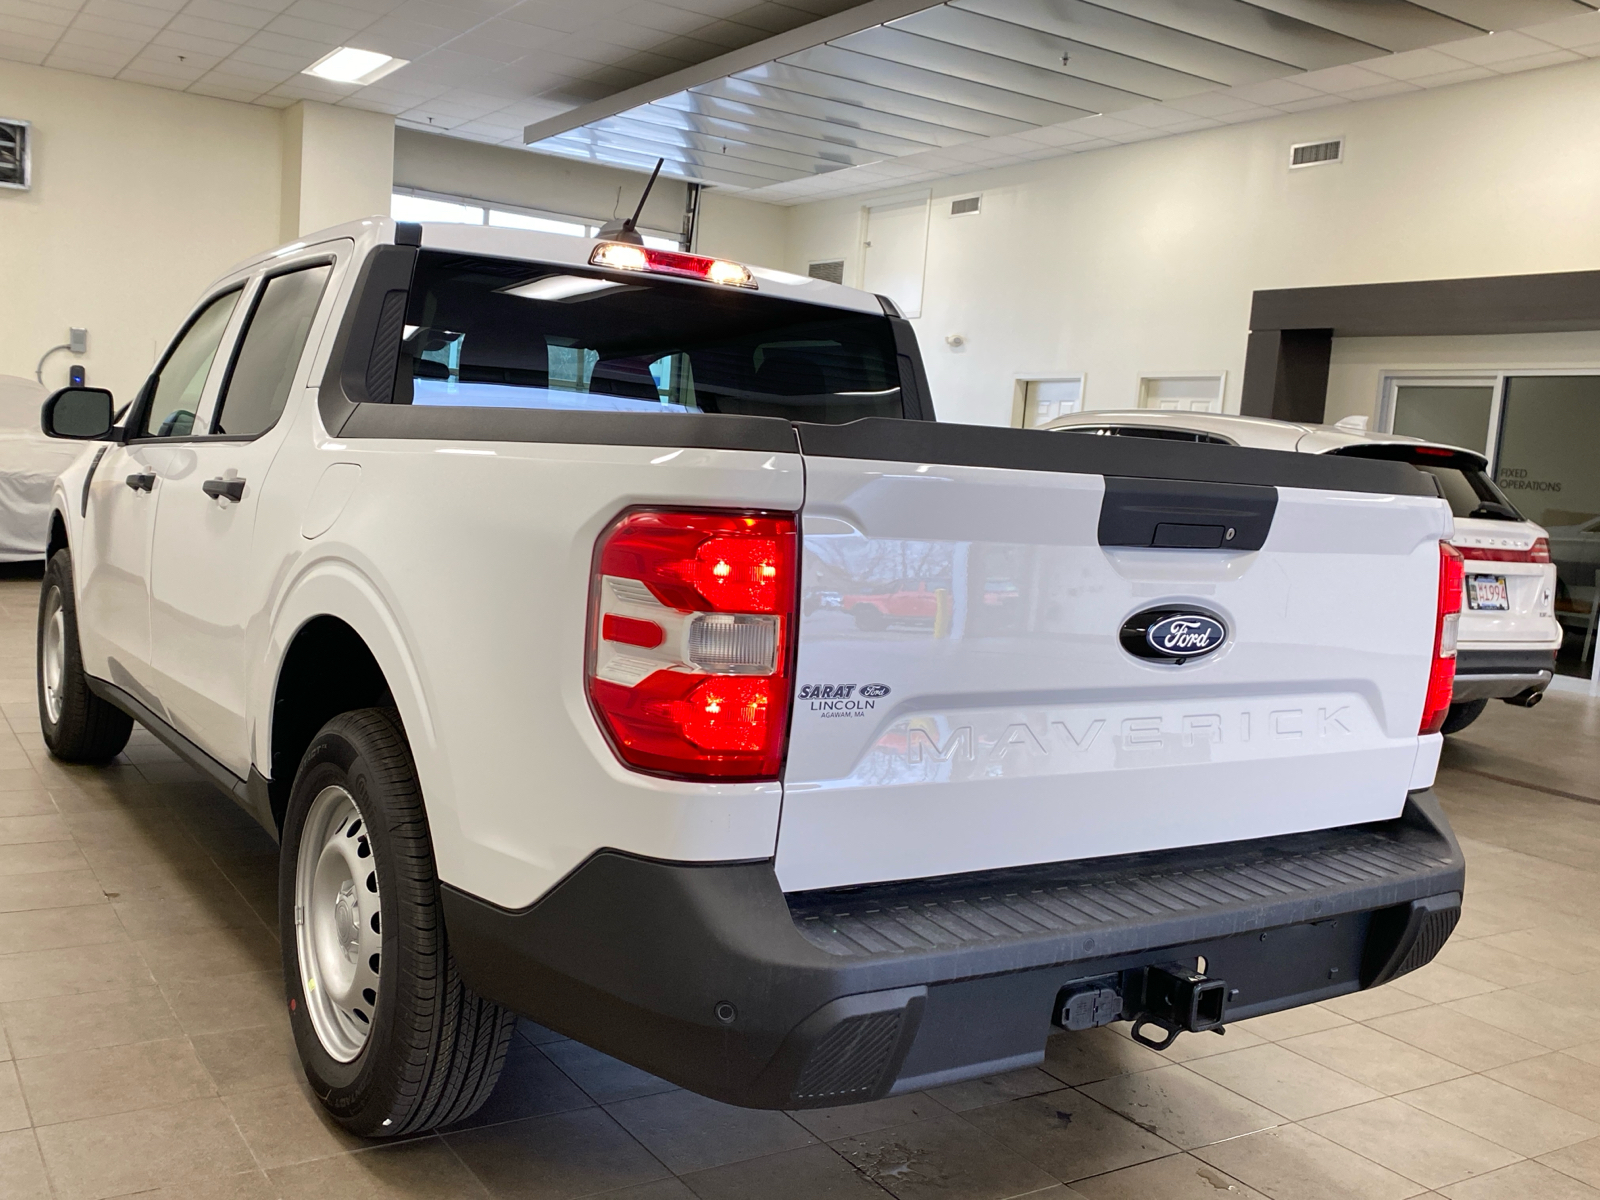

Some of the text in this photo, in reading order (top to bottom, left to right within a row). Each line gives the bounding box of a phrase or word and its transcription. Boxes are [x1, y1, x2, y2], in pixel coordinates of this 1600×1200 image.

[1500, 468, 1527, 479] FIXED
[1500, 480, 1562, 492] OPERATIONS
[1163, 619, 1213, 649] Ford
[798, 684, 888, 700] SARAT Ford
[810, 700, 875, 711] LINCOLN
[821, 711, 853, 719] AGAWAM,
[907, 705, 1352, 765] MAVERICK
